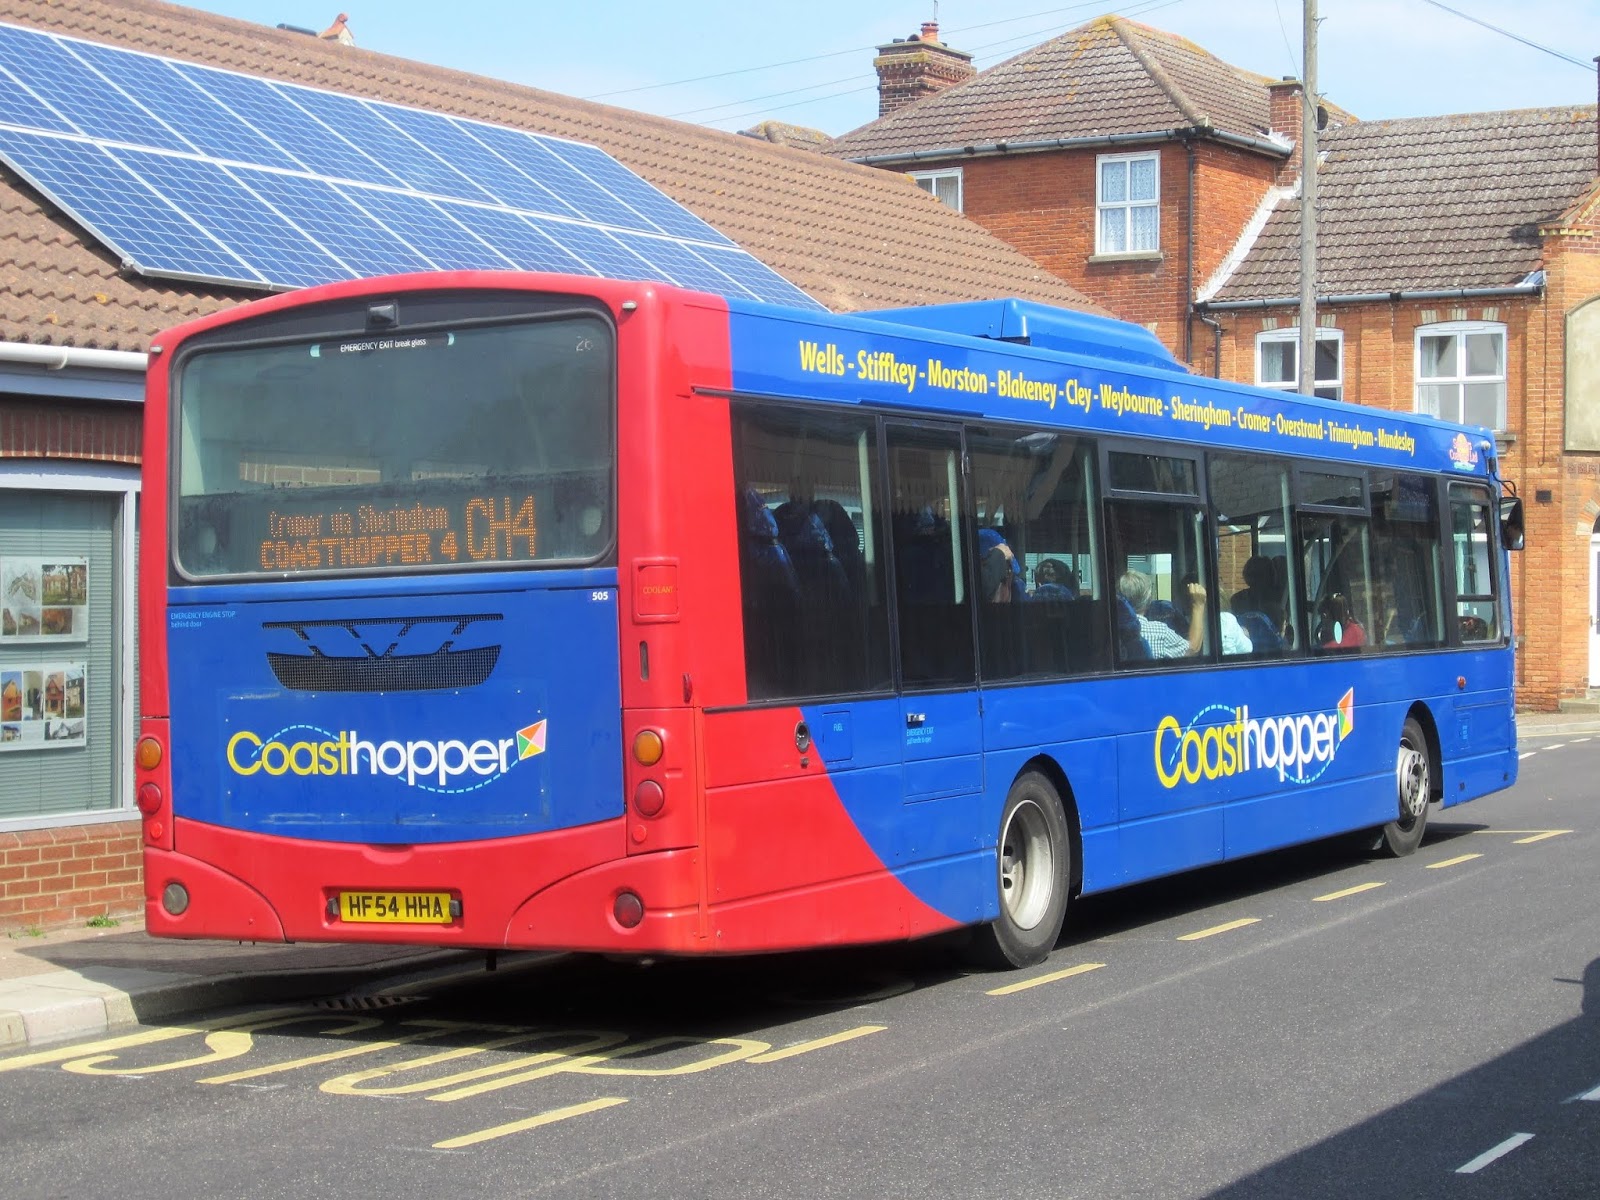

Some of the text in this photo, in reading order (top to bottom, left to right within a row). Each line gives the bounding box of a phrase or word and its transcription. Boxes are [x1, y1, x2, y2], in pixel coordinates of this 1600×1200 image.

[340, 338, 427, 353] EMERGENCY EXIT break glass
[799, 340, 845, 377] Wells
[857, 349, 917, 393] Stiffkey
[928, 359, 988, 394] Morston
[997, 370, 1057, 410] Blakeney
[1065, 379, 1092, 413] Cley
[1099, 383, 1163, 417] Weybourne
[1171, 396, 1232, 430] Sheringham
[1238, 406, 1272, 434] Cromer
[1276, 413, 1324, 441] Overstrand
[1327, 420, 1374, 451] Trimingham
[1378, 427, 1416, 457] Mundesley
[465, 495, 536, 560] CH4
[261, 531, 459, 569] COASTHOPPER 4
[592, 591, 609, 601] 505
[642, 586, 674, 594] COOLANT
[170, 610, 236, 620] EMERGENCY ENGINE STOP
[226, 730, 515, 786] Coasthopper
[1154, 704, 1338, 789] Coasthopper
[348, 895, 444, 918] HF54 HHA
